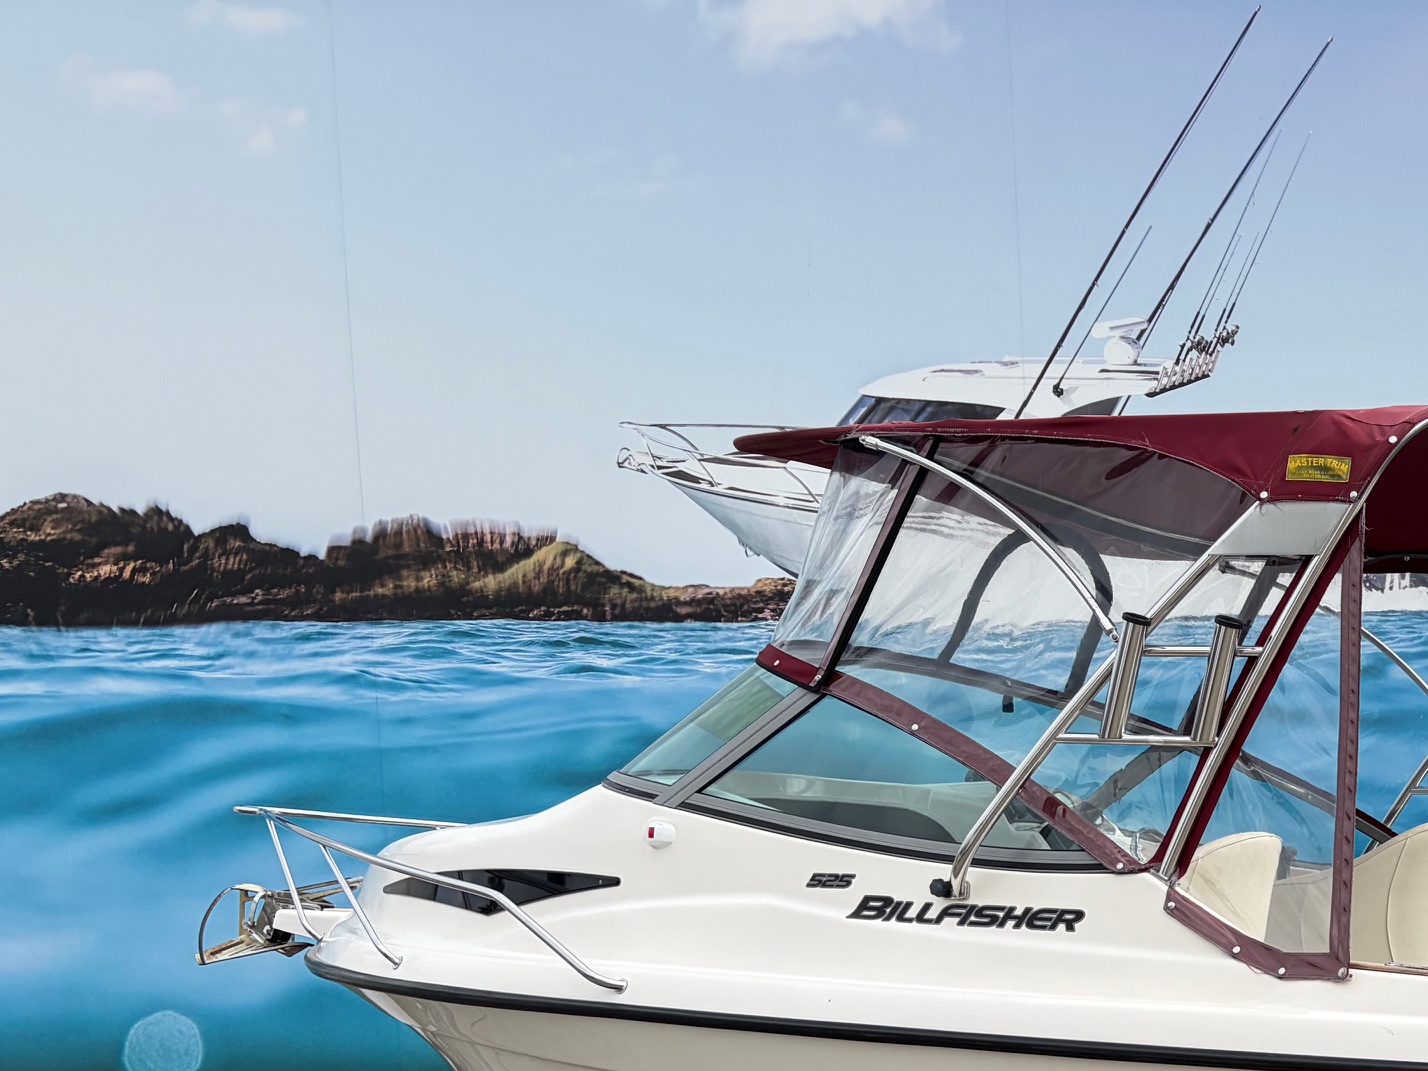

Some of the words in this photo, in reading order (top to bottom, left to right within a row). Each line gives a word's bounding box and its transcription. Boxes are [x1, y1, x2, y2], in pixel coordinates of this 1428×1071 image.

[1289, 457, 1324, 470] MASTER
[1326, 458, 1349, 472] TRIM
[806, 872, 856, 889] 525
[846, 894, 1085, 932] BILLFISHER
